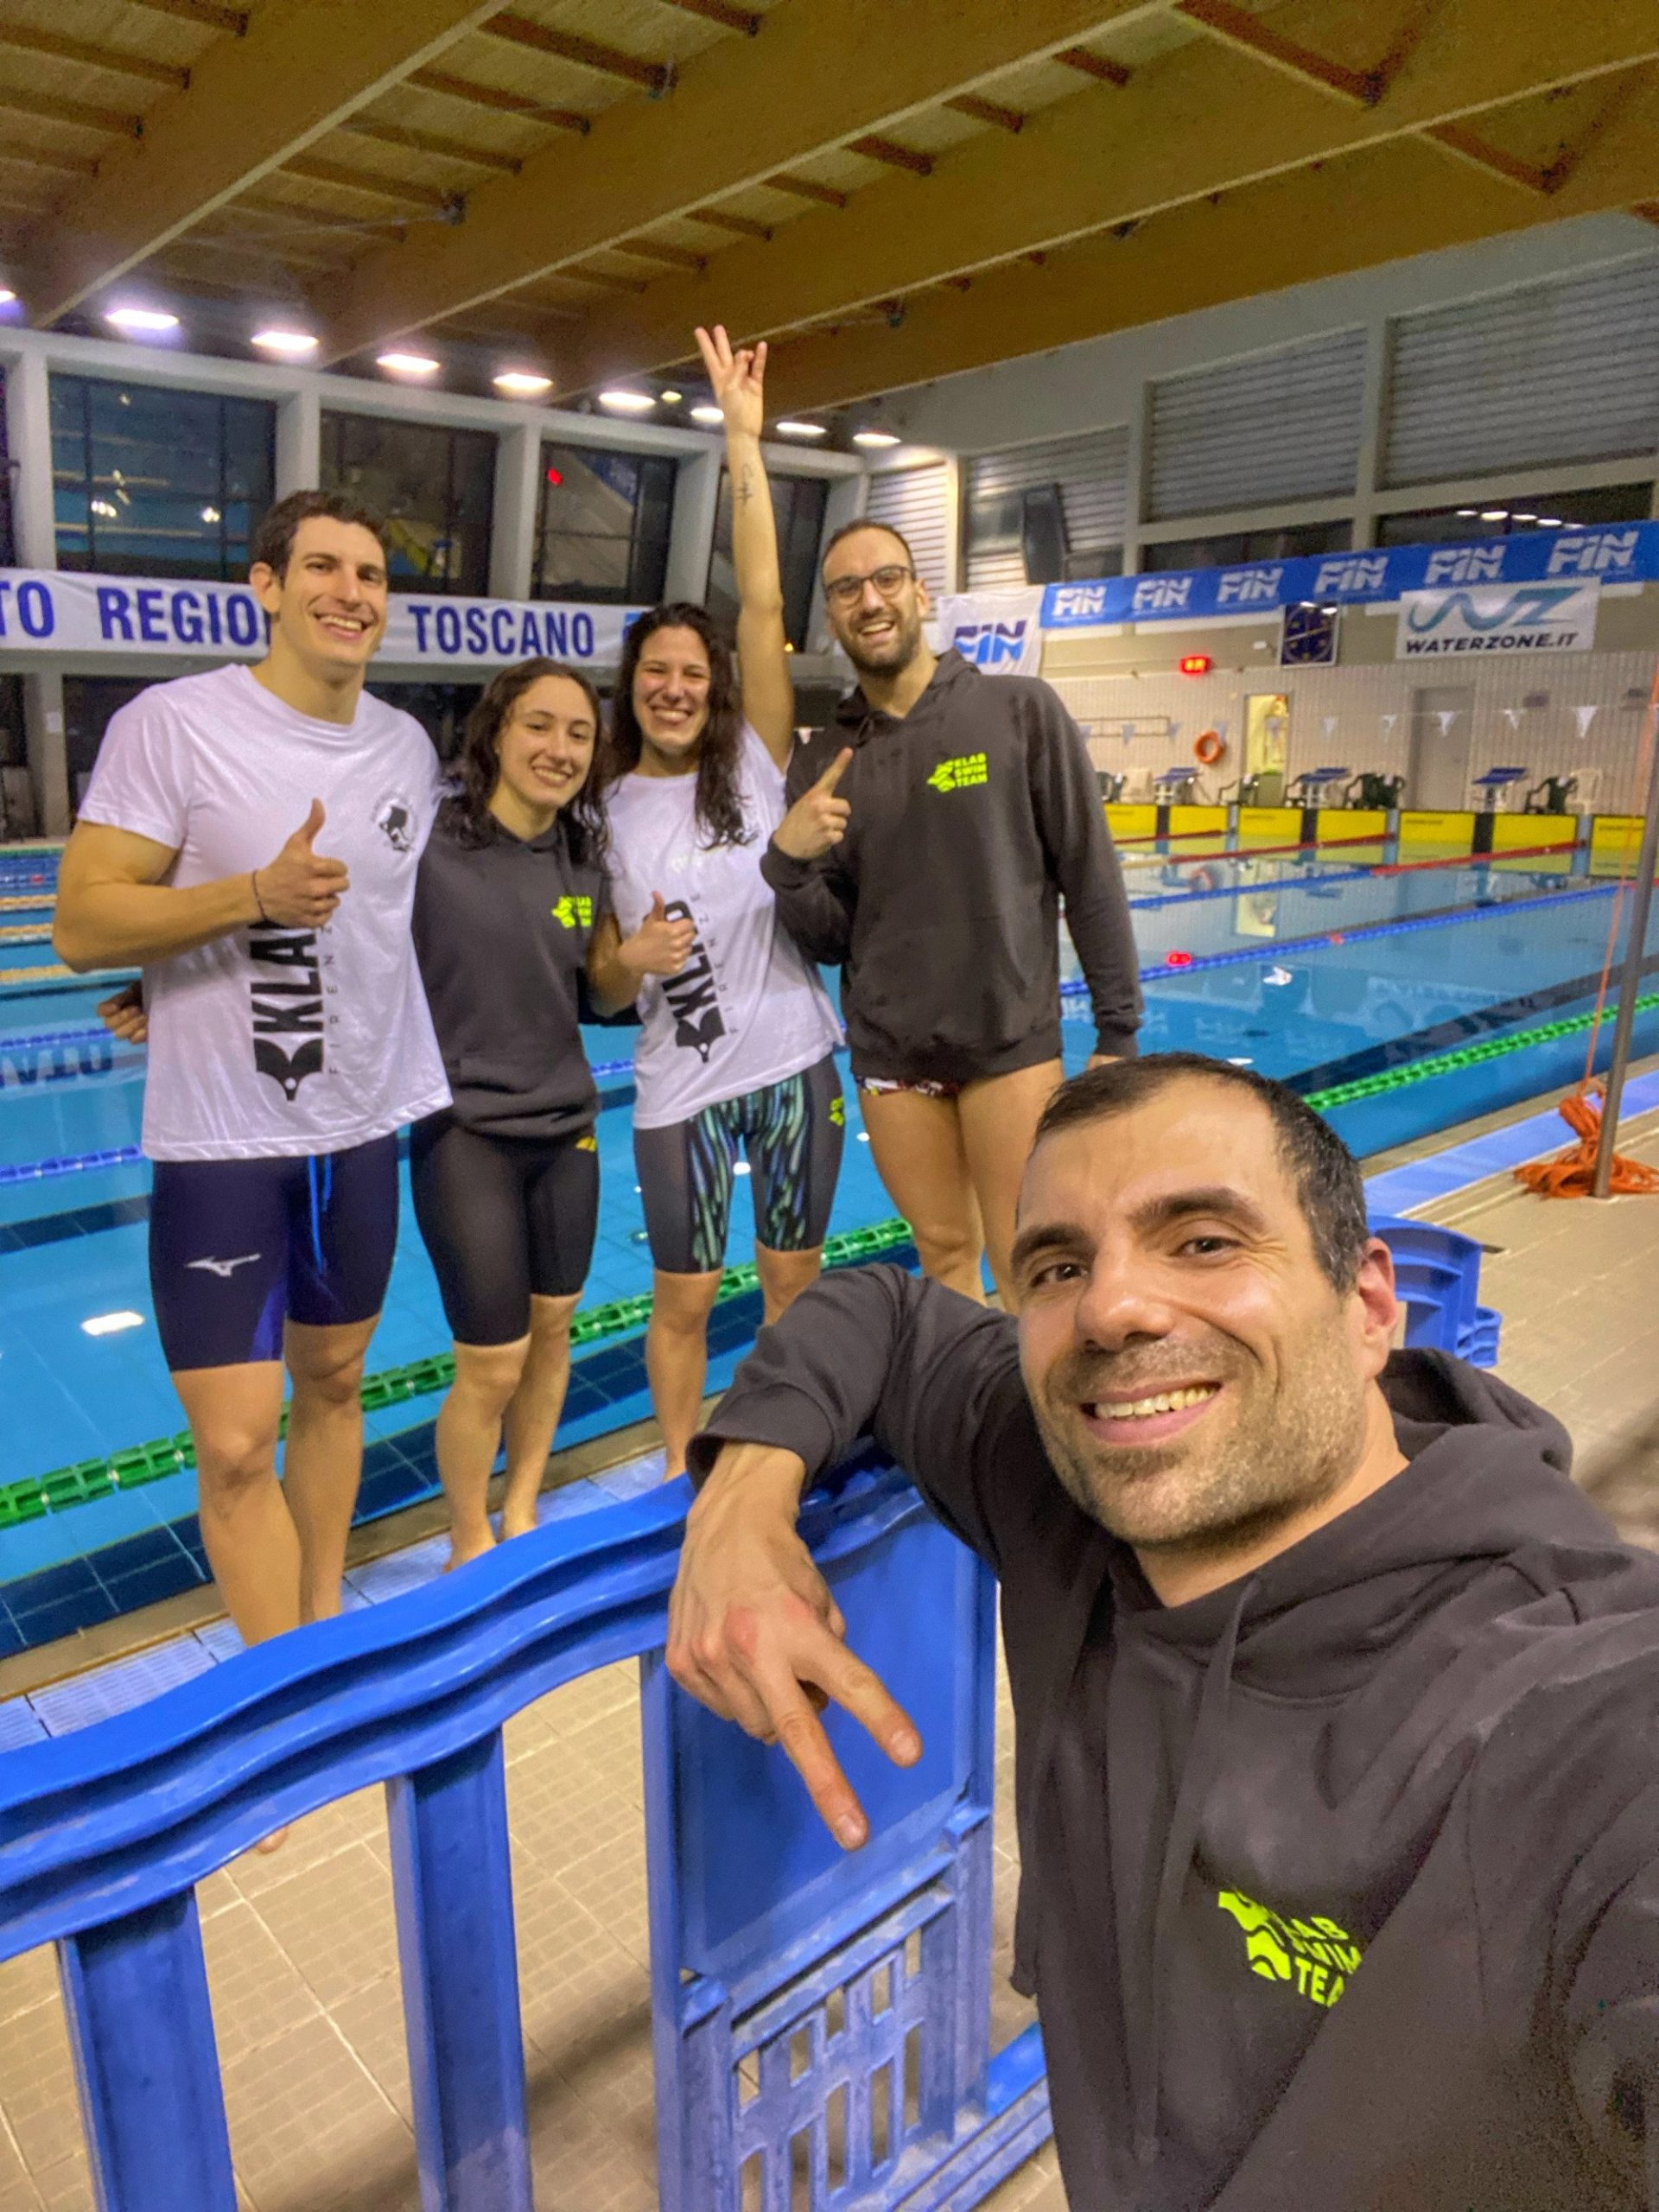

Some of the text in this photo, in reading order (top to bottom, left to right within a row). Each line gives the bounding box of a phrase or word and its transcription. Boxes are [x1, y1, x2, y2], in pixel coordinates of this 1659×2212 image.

[1052, 585, 1106, 617] FIN
[1134, 577, 1192, 611] FIN
[1216, 567, 1284, 602] FIN
[1313, 556, 1389, 594] FIN
[1424, 544, 1507, 583] FIN
[1547, 531, 1639, 574] FIN
[96, 587, 271, 646] REGIO
[407, 604, 594, 658] TOSCANO
[954, 620, 1027, 664] FIN
[1405, 632, 1579, 655] WATERZONE.IT
[249, 920, 324, 1033] KLA
[1294, 1955, 1345, 2009] TEA
